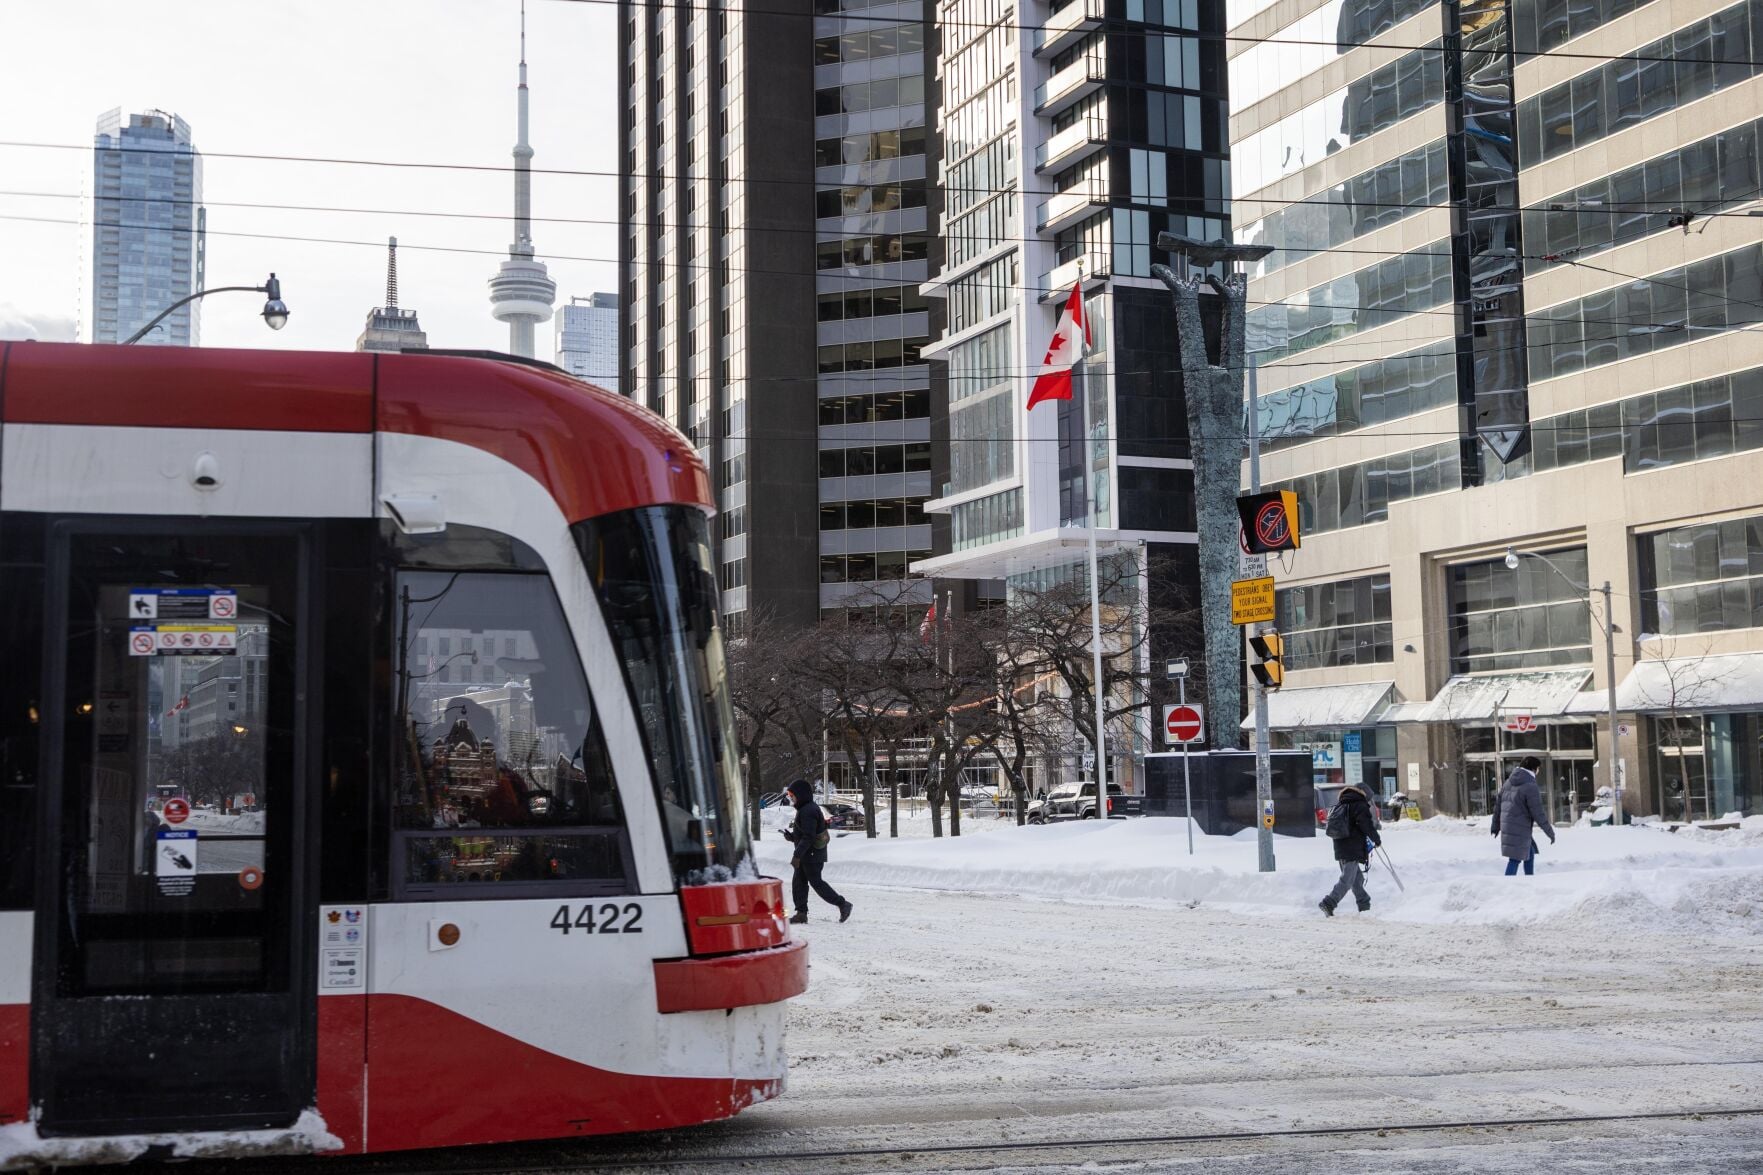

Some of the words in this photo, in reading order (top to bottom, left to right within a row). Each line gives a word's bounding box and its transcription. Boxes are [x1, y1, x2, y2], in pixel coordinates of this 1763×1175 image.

[1232, 585, 1259, 597] PEDESTRIANS
[1262, 584, 1273, 593] OBEY
[1239, 597, 1251, 606] YOUR
[1252, 595, 1268, 605] SIGNAL
[1233, 610, 1242, 618] TWO
[1242, 608, 1254, 617] STAGE
[1254, 606, 1274, 616] CROSSING
[1084, 760, 1094, 769] 40
[550, 903, 643, 935] 4422
